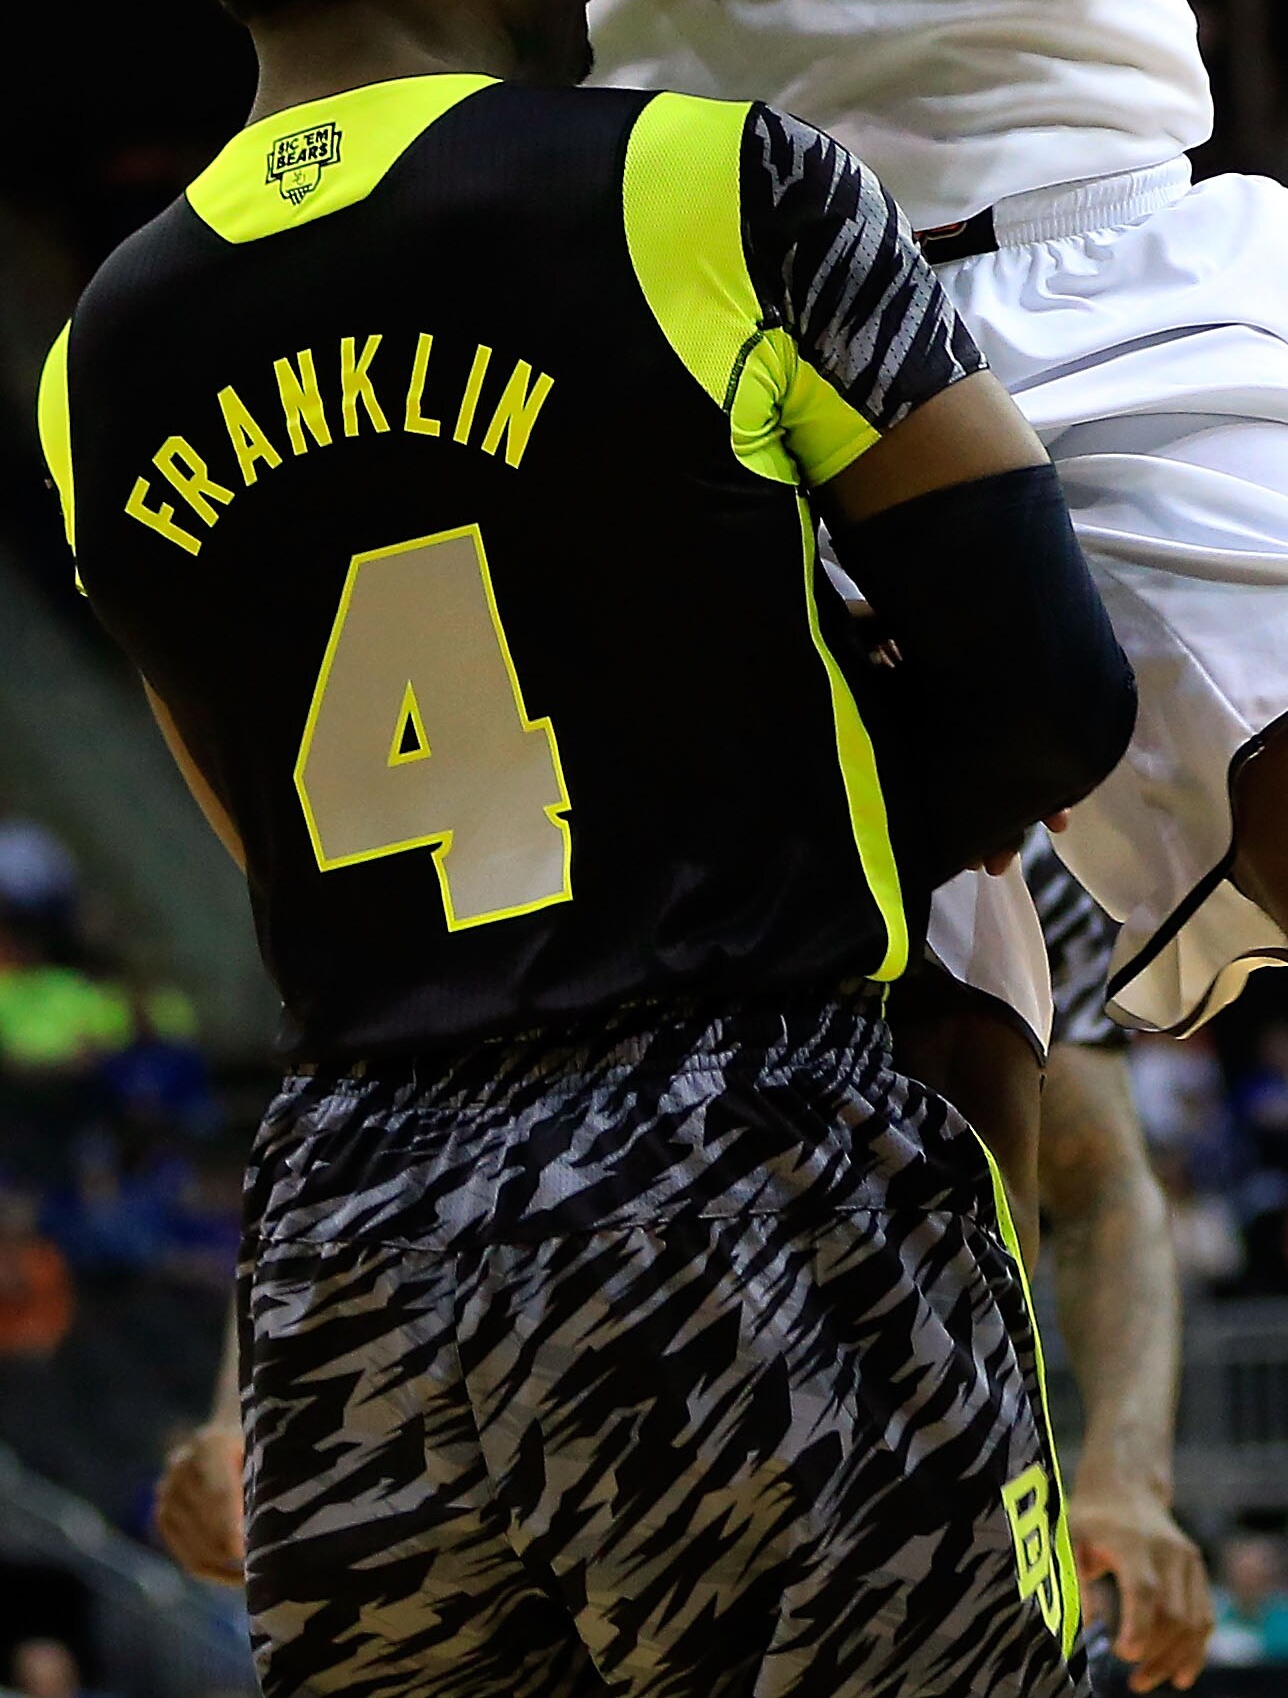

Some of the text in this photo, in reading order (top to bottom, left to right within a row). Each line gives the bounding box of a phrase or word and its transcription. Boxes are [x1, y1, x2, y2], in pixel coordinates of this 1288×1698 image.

[276, 143, 328, 170] BEARS
[277, 138, 300, 155] SIC
[124, 332, 555, 556] FRANKLIN
[293, 522, 573, 933] 4
